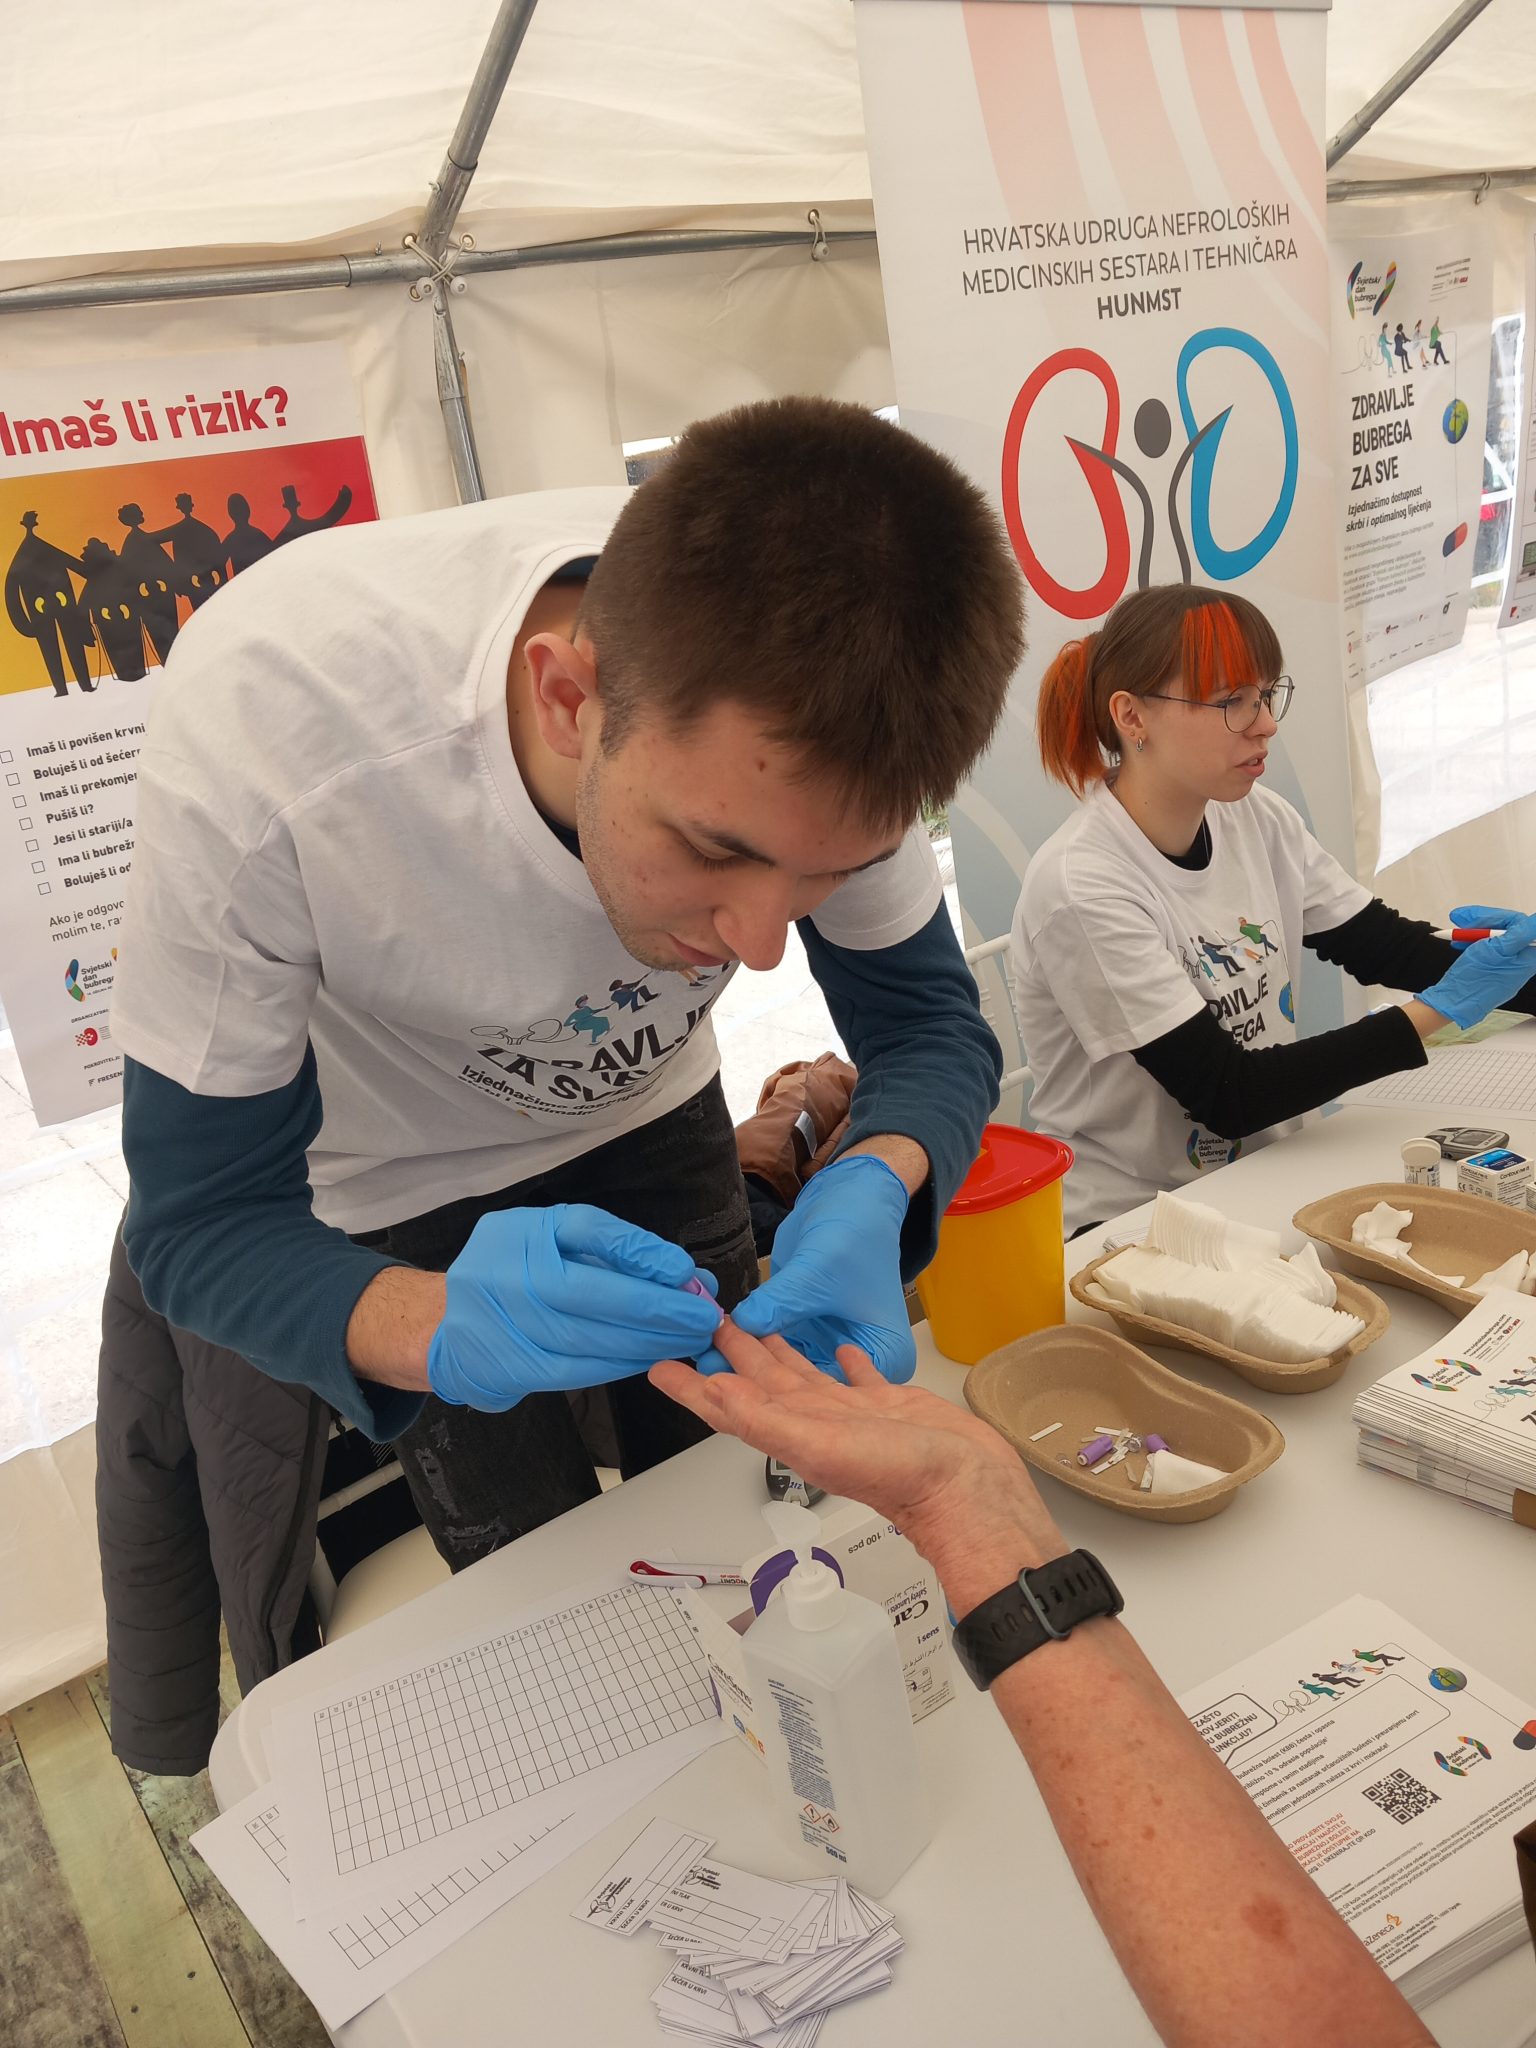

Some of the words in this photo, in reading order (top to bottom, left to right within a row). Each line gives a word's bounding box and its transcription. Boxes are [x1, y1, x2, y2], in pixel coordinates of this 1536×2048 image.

[964, 221, 1071, 255] HRVATSKA
[1073, 214, 1160, 245] UDRUGA
[1162, 200, 1290, 237] NEFROLOŠKIH
[962, 259, 1094, 296] MEDICINSKIH
[1099, 250, 1181, 281] SESTARA
[1184, 250, 1189, 272] I
[1193, 235, 1298, 271] TEHNIČARA
[1097, 287, 1182, 319] HUNMST
[1352, 384, 1415, 421] ZDRAVLJE
[0, 399, 118, 456] Imaš
[122, 399, 158, 442] li
[165, 386, 288, 438] rizik?
[1352, 419, 1413, 456] BUBREGA
[1351, 465, 1373, 490] ZA
[1375, 456, 1399, 484] SVE
[27, 741, 56, 758] Imaš
[58, 738, 67, 750] li
[69, 731, 113, 749] povišen
[114, 723, 146, 738] krvni
[33, 760, 77, 780] Boluješ
[79, 758, 88, 769] li
[90, 755, 104, 767] od
[39, 784, 69, 802] Imaš
[71, 783, 79, 795] li
[46, 806, 78, 824] Pušiš
[80, 803, 94, 815] li?
[52, 831, 76, 845] Jesi
[78, 828, 86, 839] li
[88, 817, 133, 836] stariji/a
[58, 855, 80, 867] Ima
[82, 849, 91, 861] li
[64, 868, 107, 888] Boluješ
[109, 866, 117, 877] li
[49, 914, 71, 928] Ako
[73, 910, 84, 922] je
[52, 925, 88, 942] molim
[90, 921, 106, 932] te,
[108, 916, 122, 927] ra
[81, 960, 112, 975] Svjetski
[82, 972, 98, 982] dan
[97, 1071, 124, 1084] FRESEN
[864, 1532, 882, 1545] 100
[1194, 1709, 1222, 1728] ZAŠTO
